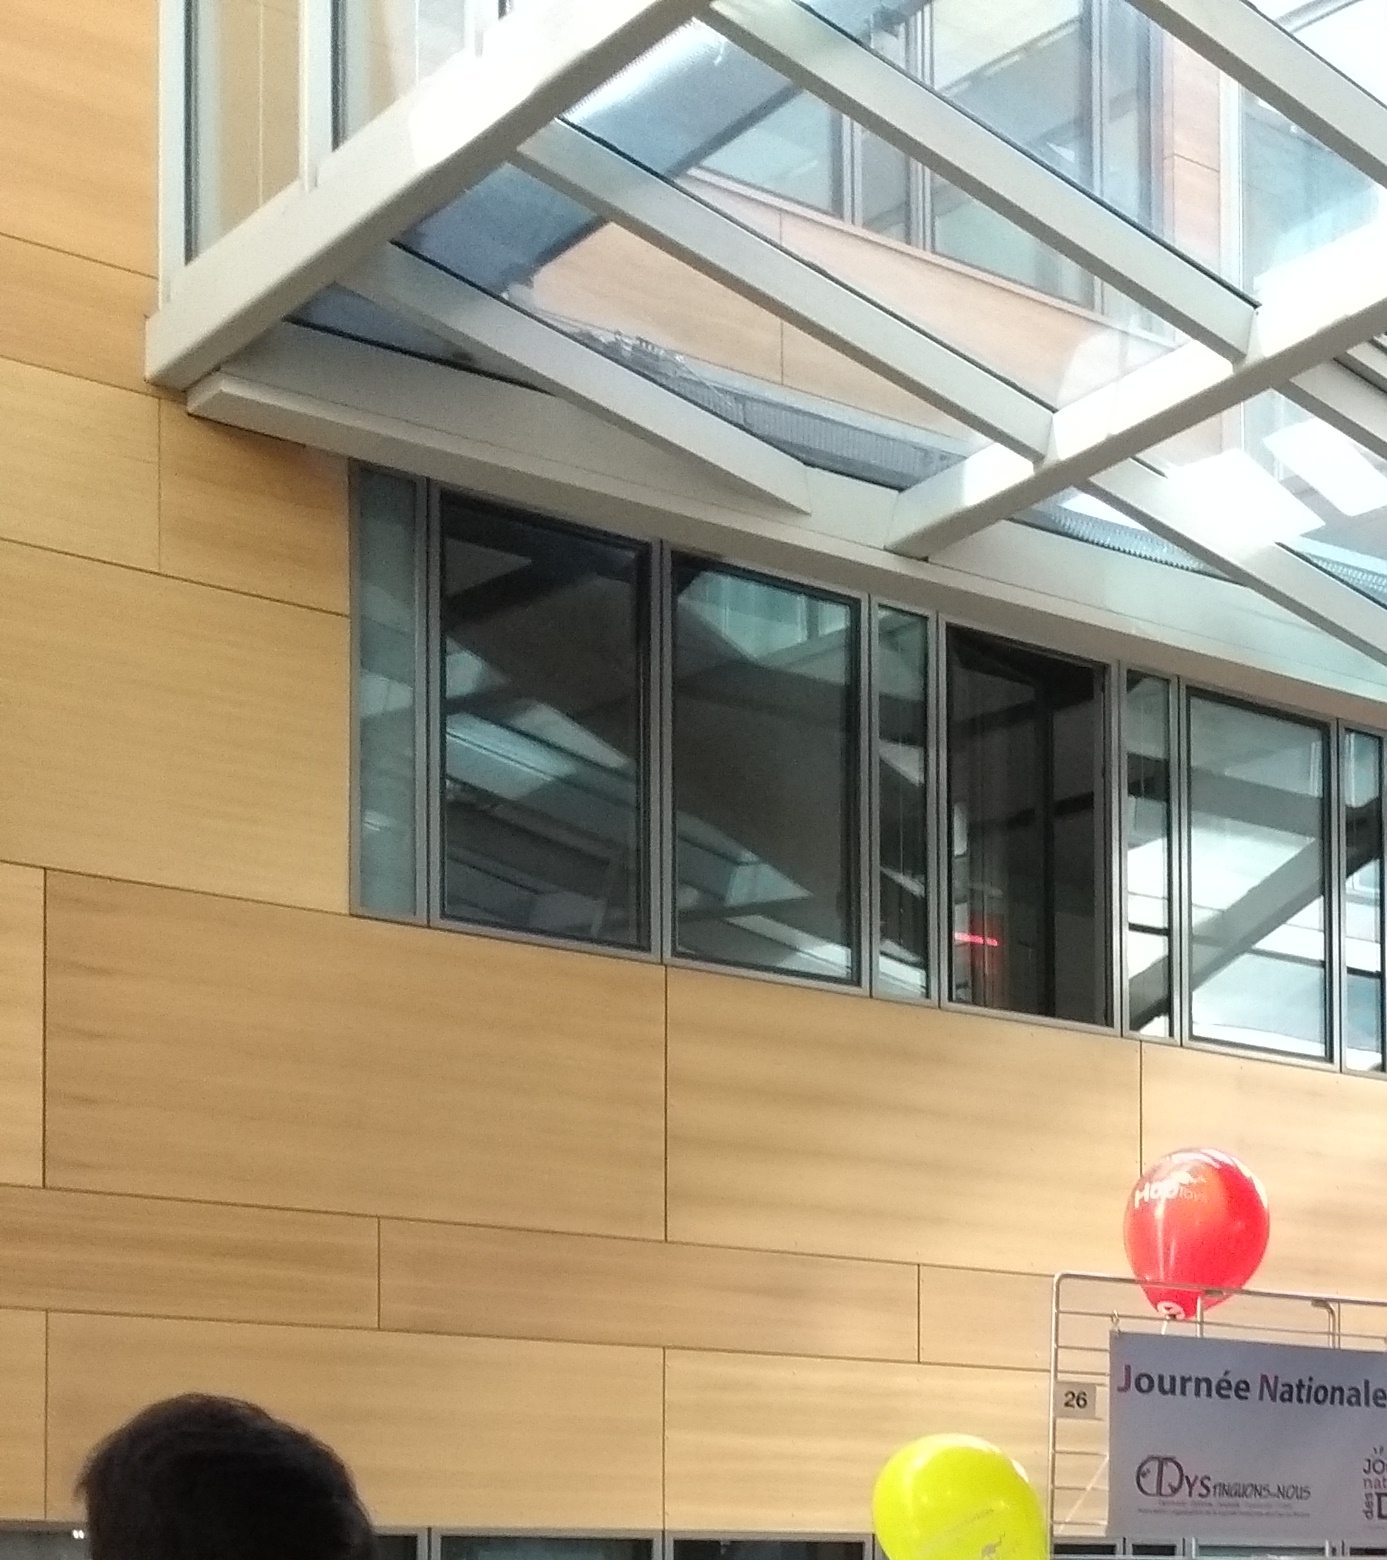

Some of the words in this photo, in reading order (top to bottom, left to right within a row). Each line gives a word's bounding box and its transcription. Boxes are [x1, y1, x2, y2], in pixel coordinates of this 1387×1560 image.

[1064, 1390, 1088, 1409] 26
[1117, 1364, 1251, 1401] Journée
[1258, 1373, 1387, 1409] Nationale
